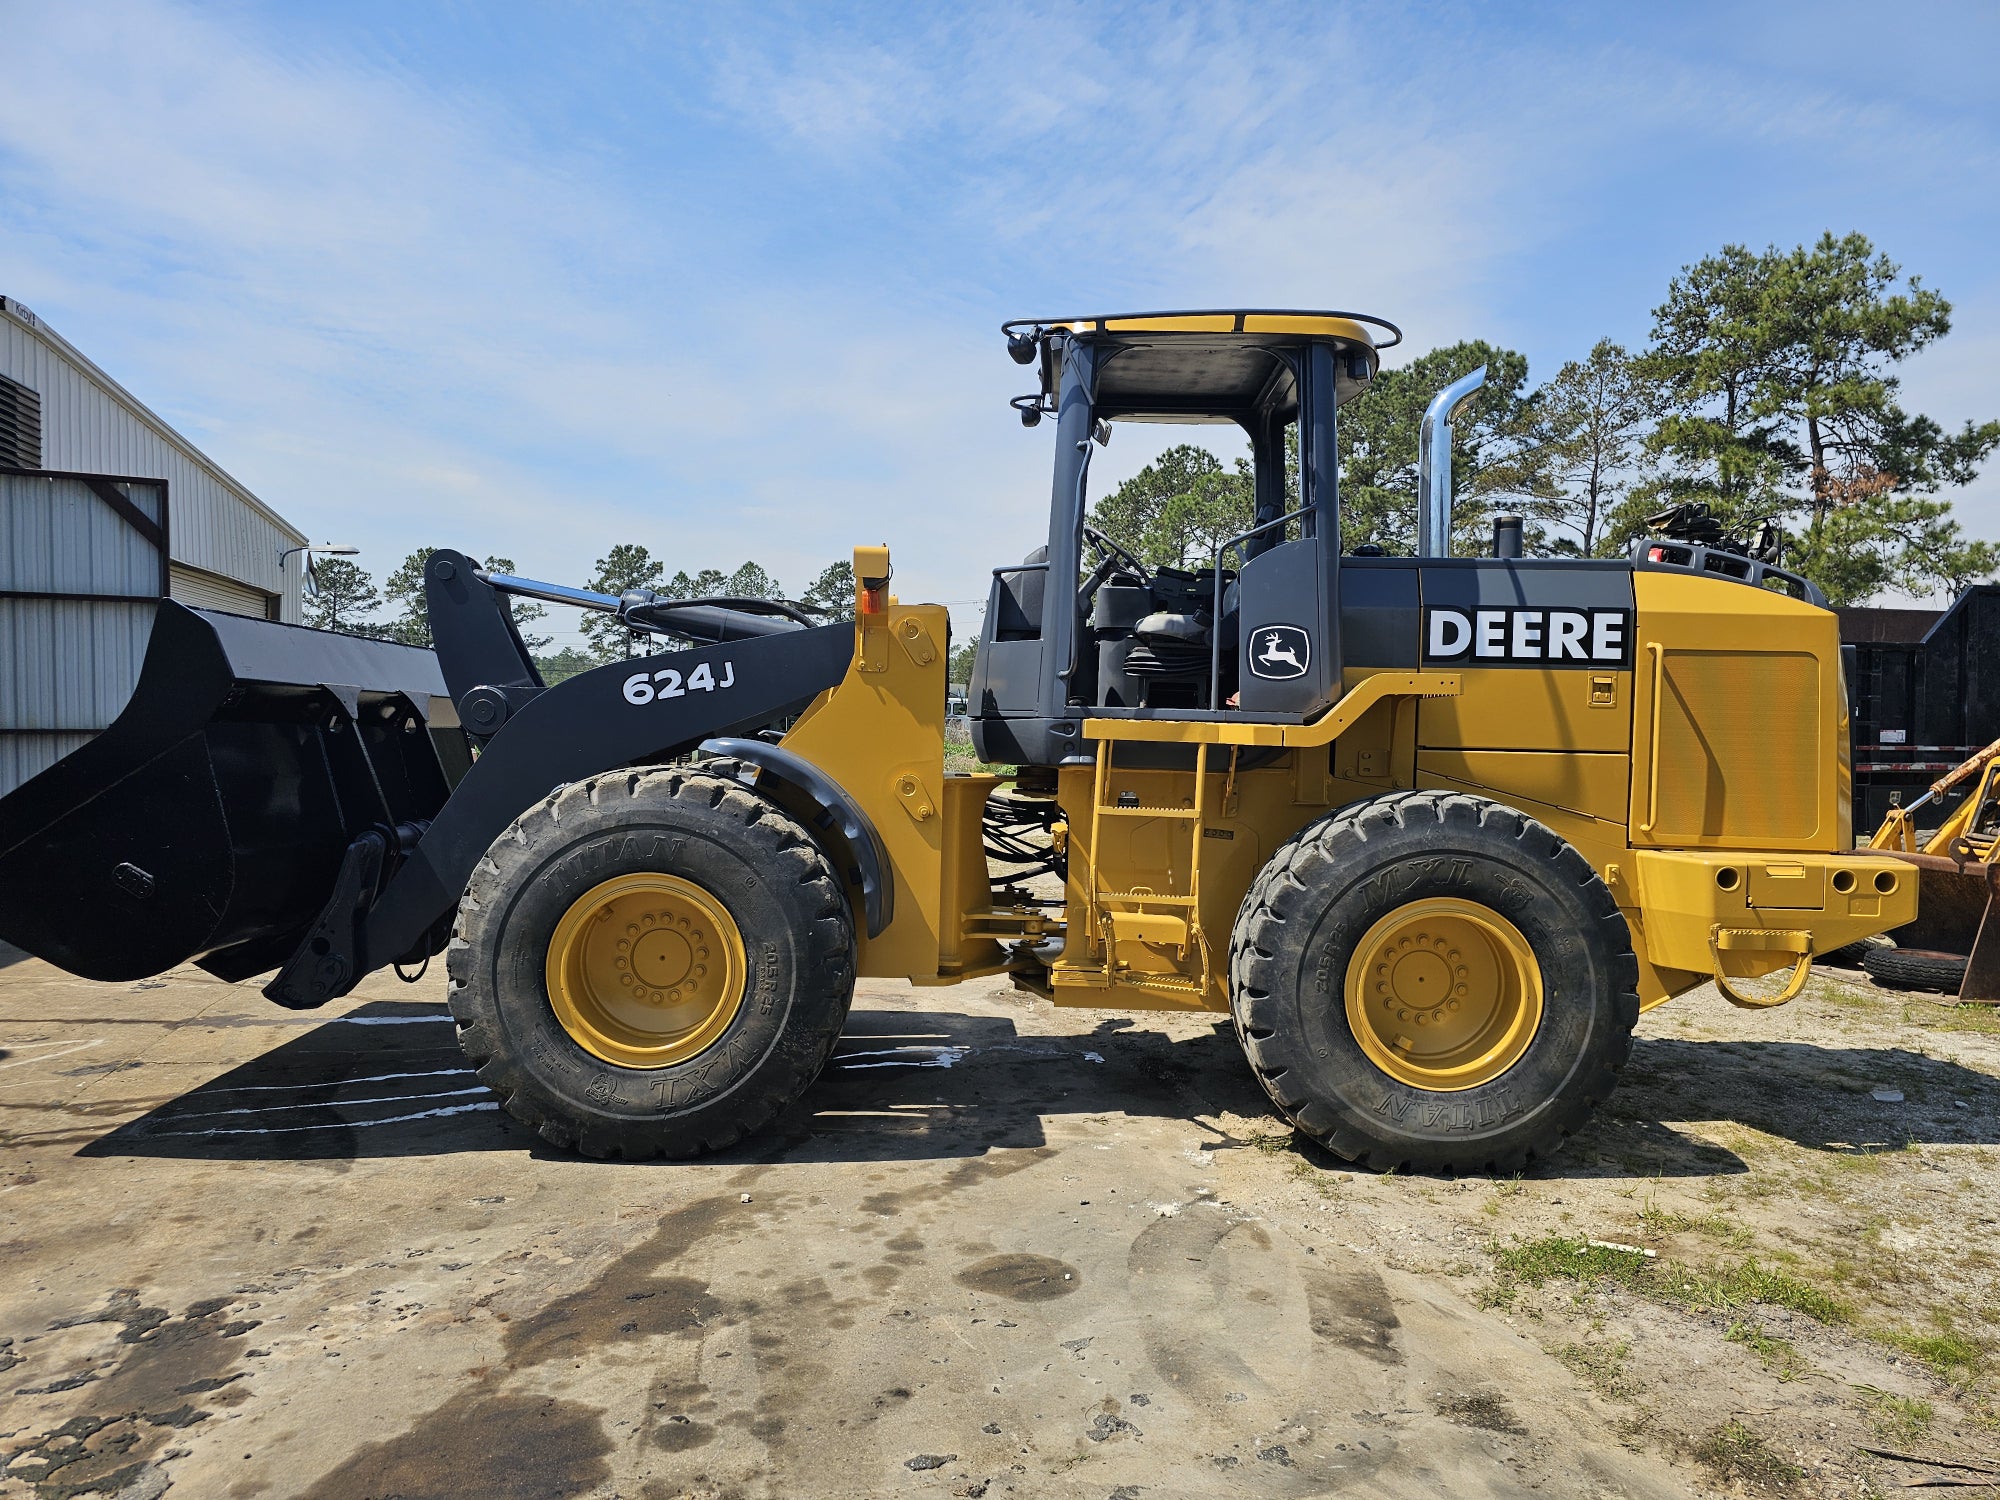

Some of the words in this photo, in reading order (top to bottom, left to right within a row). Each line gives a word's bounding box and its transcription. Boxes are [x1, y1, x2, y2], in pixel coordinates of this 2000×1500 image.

[1429, 609, 1624, 660] DEERE
[622, 660, 736, 706] 624J
[541, 836, 688, 897] TITAN
[1357, 857, 1474, 913] MXL
[650, 1027, 760, 1109] MXL
[1373, 1086, 1525, 1132] TITAN
